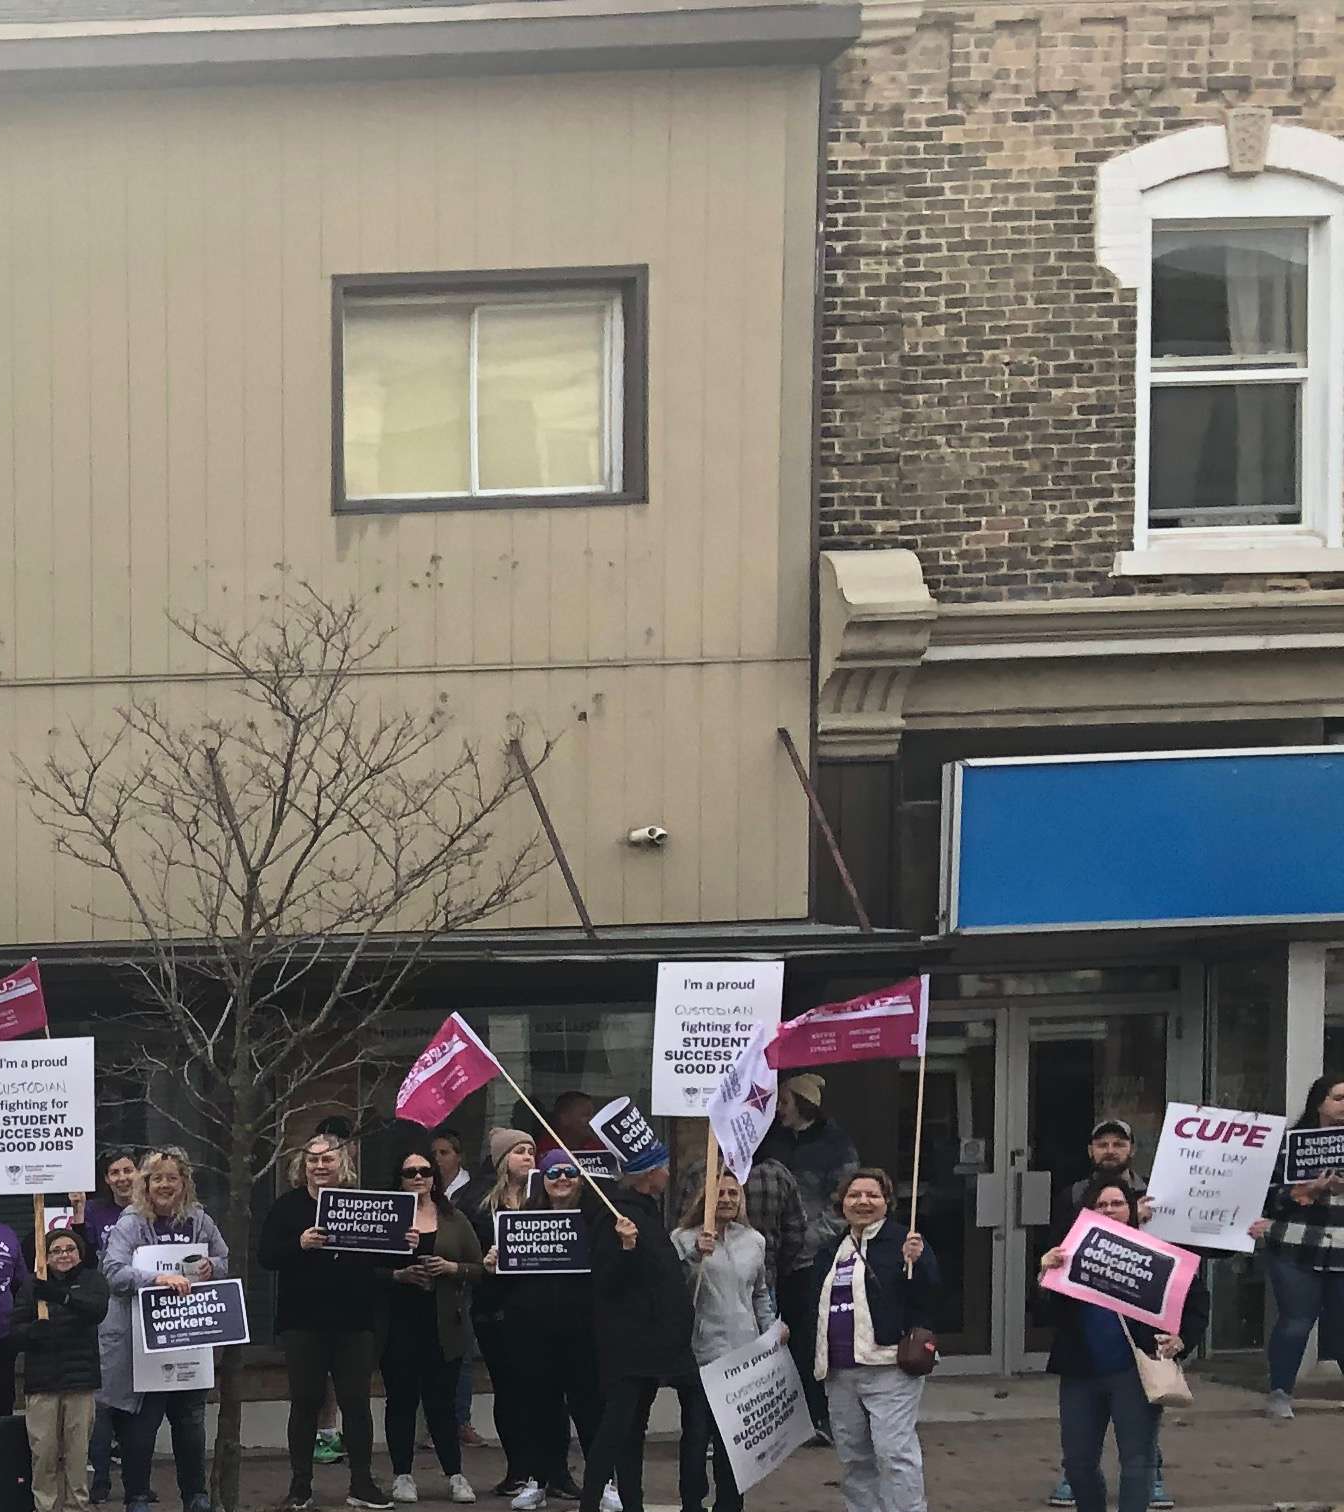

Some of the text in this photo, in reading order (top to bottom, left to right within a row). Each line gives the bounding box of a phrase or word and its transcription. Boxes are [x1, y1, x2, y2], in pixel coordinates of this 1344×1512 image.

[684, 979, 755, 992] I'm a proud
[674, 1005, 753, 1016] CUSTODIAN
[681, 1021, 753, 1034] fighting for
[682, 1037, 750, 1048] STUDENT
[664, 1051, 732, 1061] SUCCESS
[0, 1055, 68, 1071] I'm a proud
[674, 1065, 716, 1074] GOOD
[0, 1099, 69, 1112] fighting for
[2, 1114, 67, 1126] STUDENT
[54, 1126, 84, 1138] AND
[1174, 1117, 1271, 1148] CUPE
[38, 1140, 74, 1152] JOBS
[1177, 1148, 1248, 1164] THE DAY
[1189, 1165, 1233, 1177] BEGINS
[1188, 1188, 1221, 1198] ENDS
[506, 1218, 570, 1232] I support
[506, 1230, 578, 1242] education
[506, 1242, 568, 1254] workers.
[1090, 1232, 1153, 1266] I support
[1084, 1247, 1153, 1281] education
[1080, 1259, 1140, 1290] workers.
